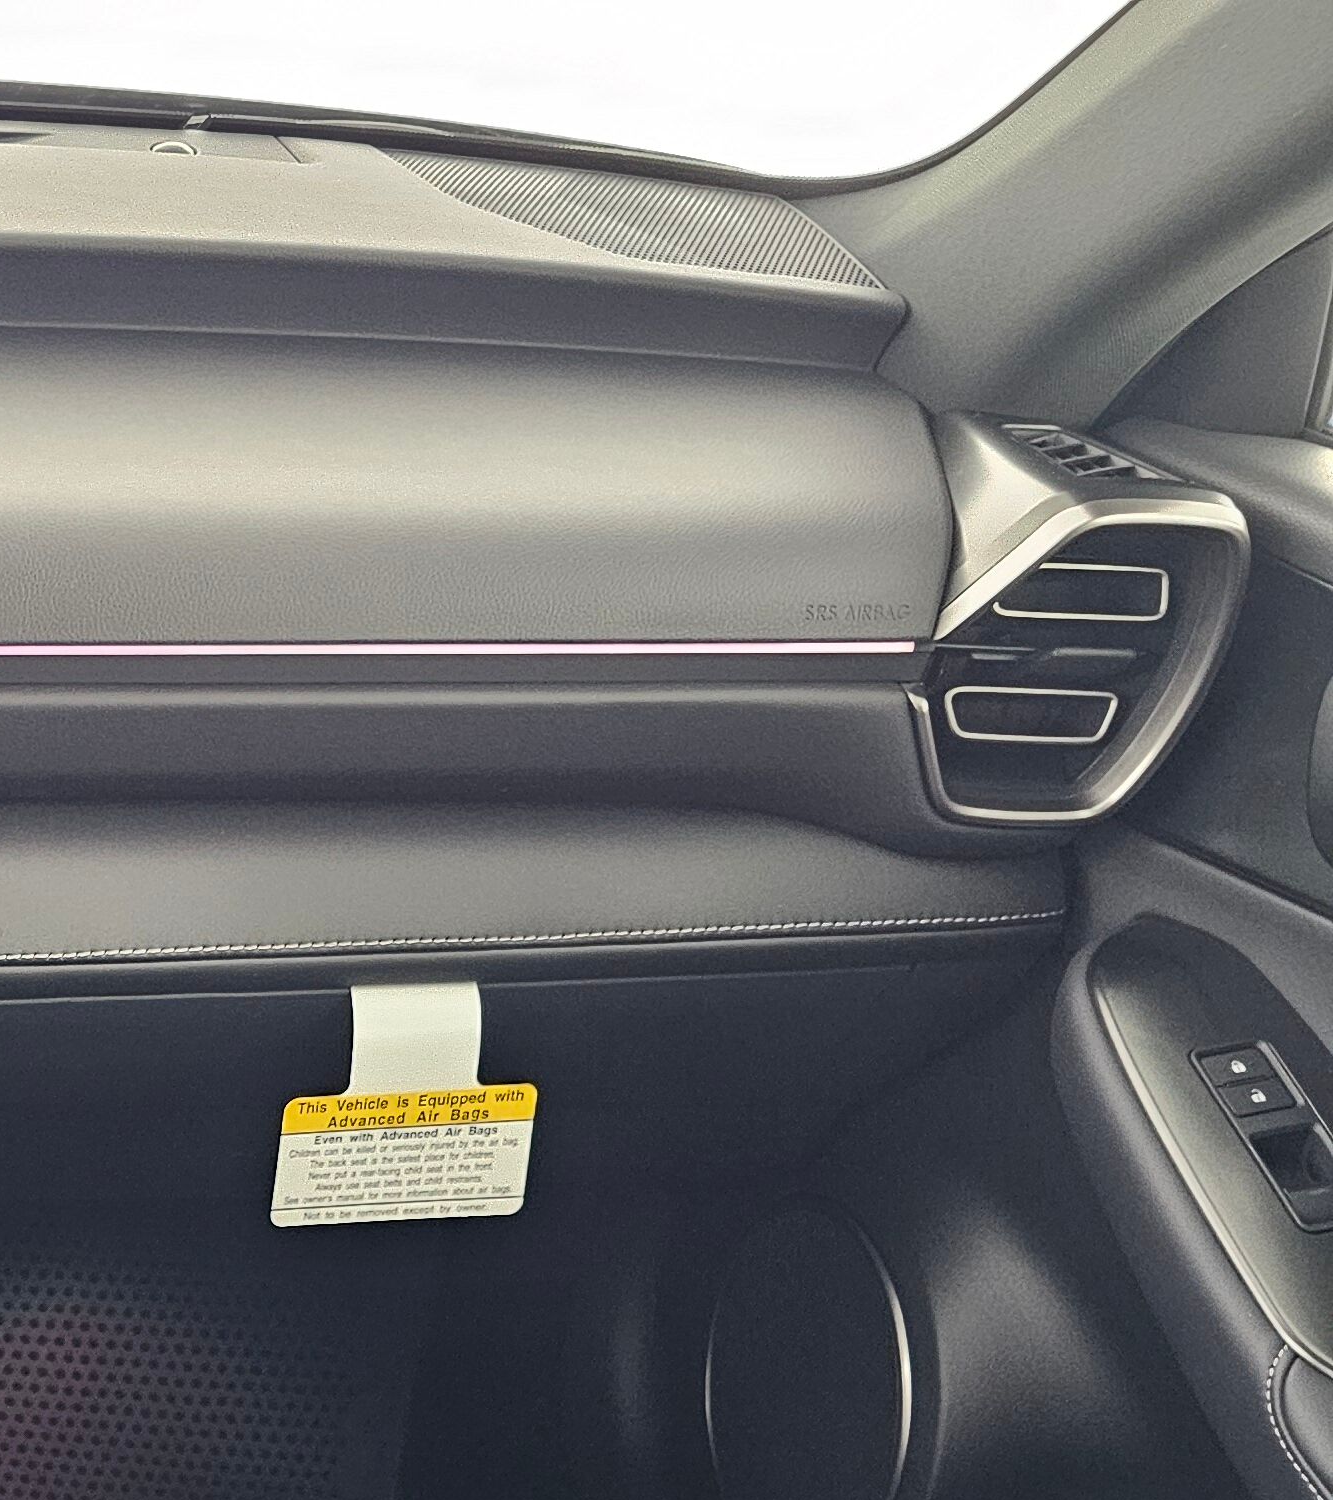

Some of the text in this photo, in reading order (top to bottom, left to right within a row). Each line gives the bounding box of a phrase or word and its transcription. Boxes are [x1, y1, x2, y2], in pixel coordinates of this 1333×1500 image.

[805, 604, 912, 622] SRS AIRBAG
[298, 1089, 525, 1114] This Vehicle is Equipped with
[327, 1109, 489, 1128] Advanced Air Bags
[314, 1126, 498, 1145] Even with Advanced Air Bags
